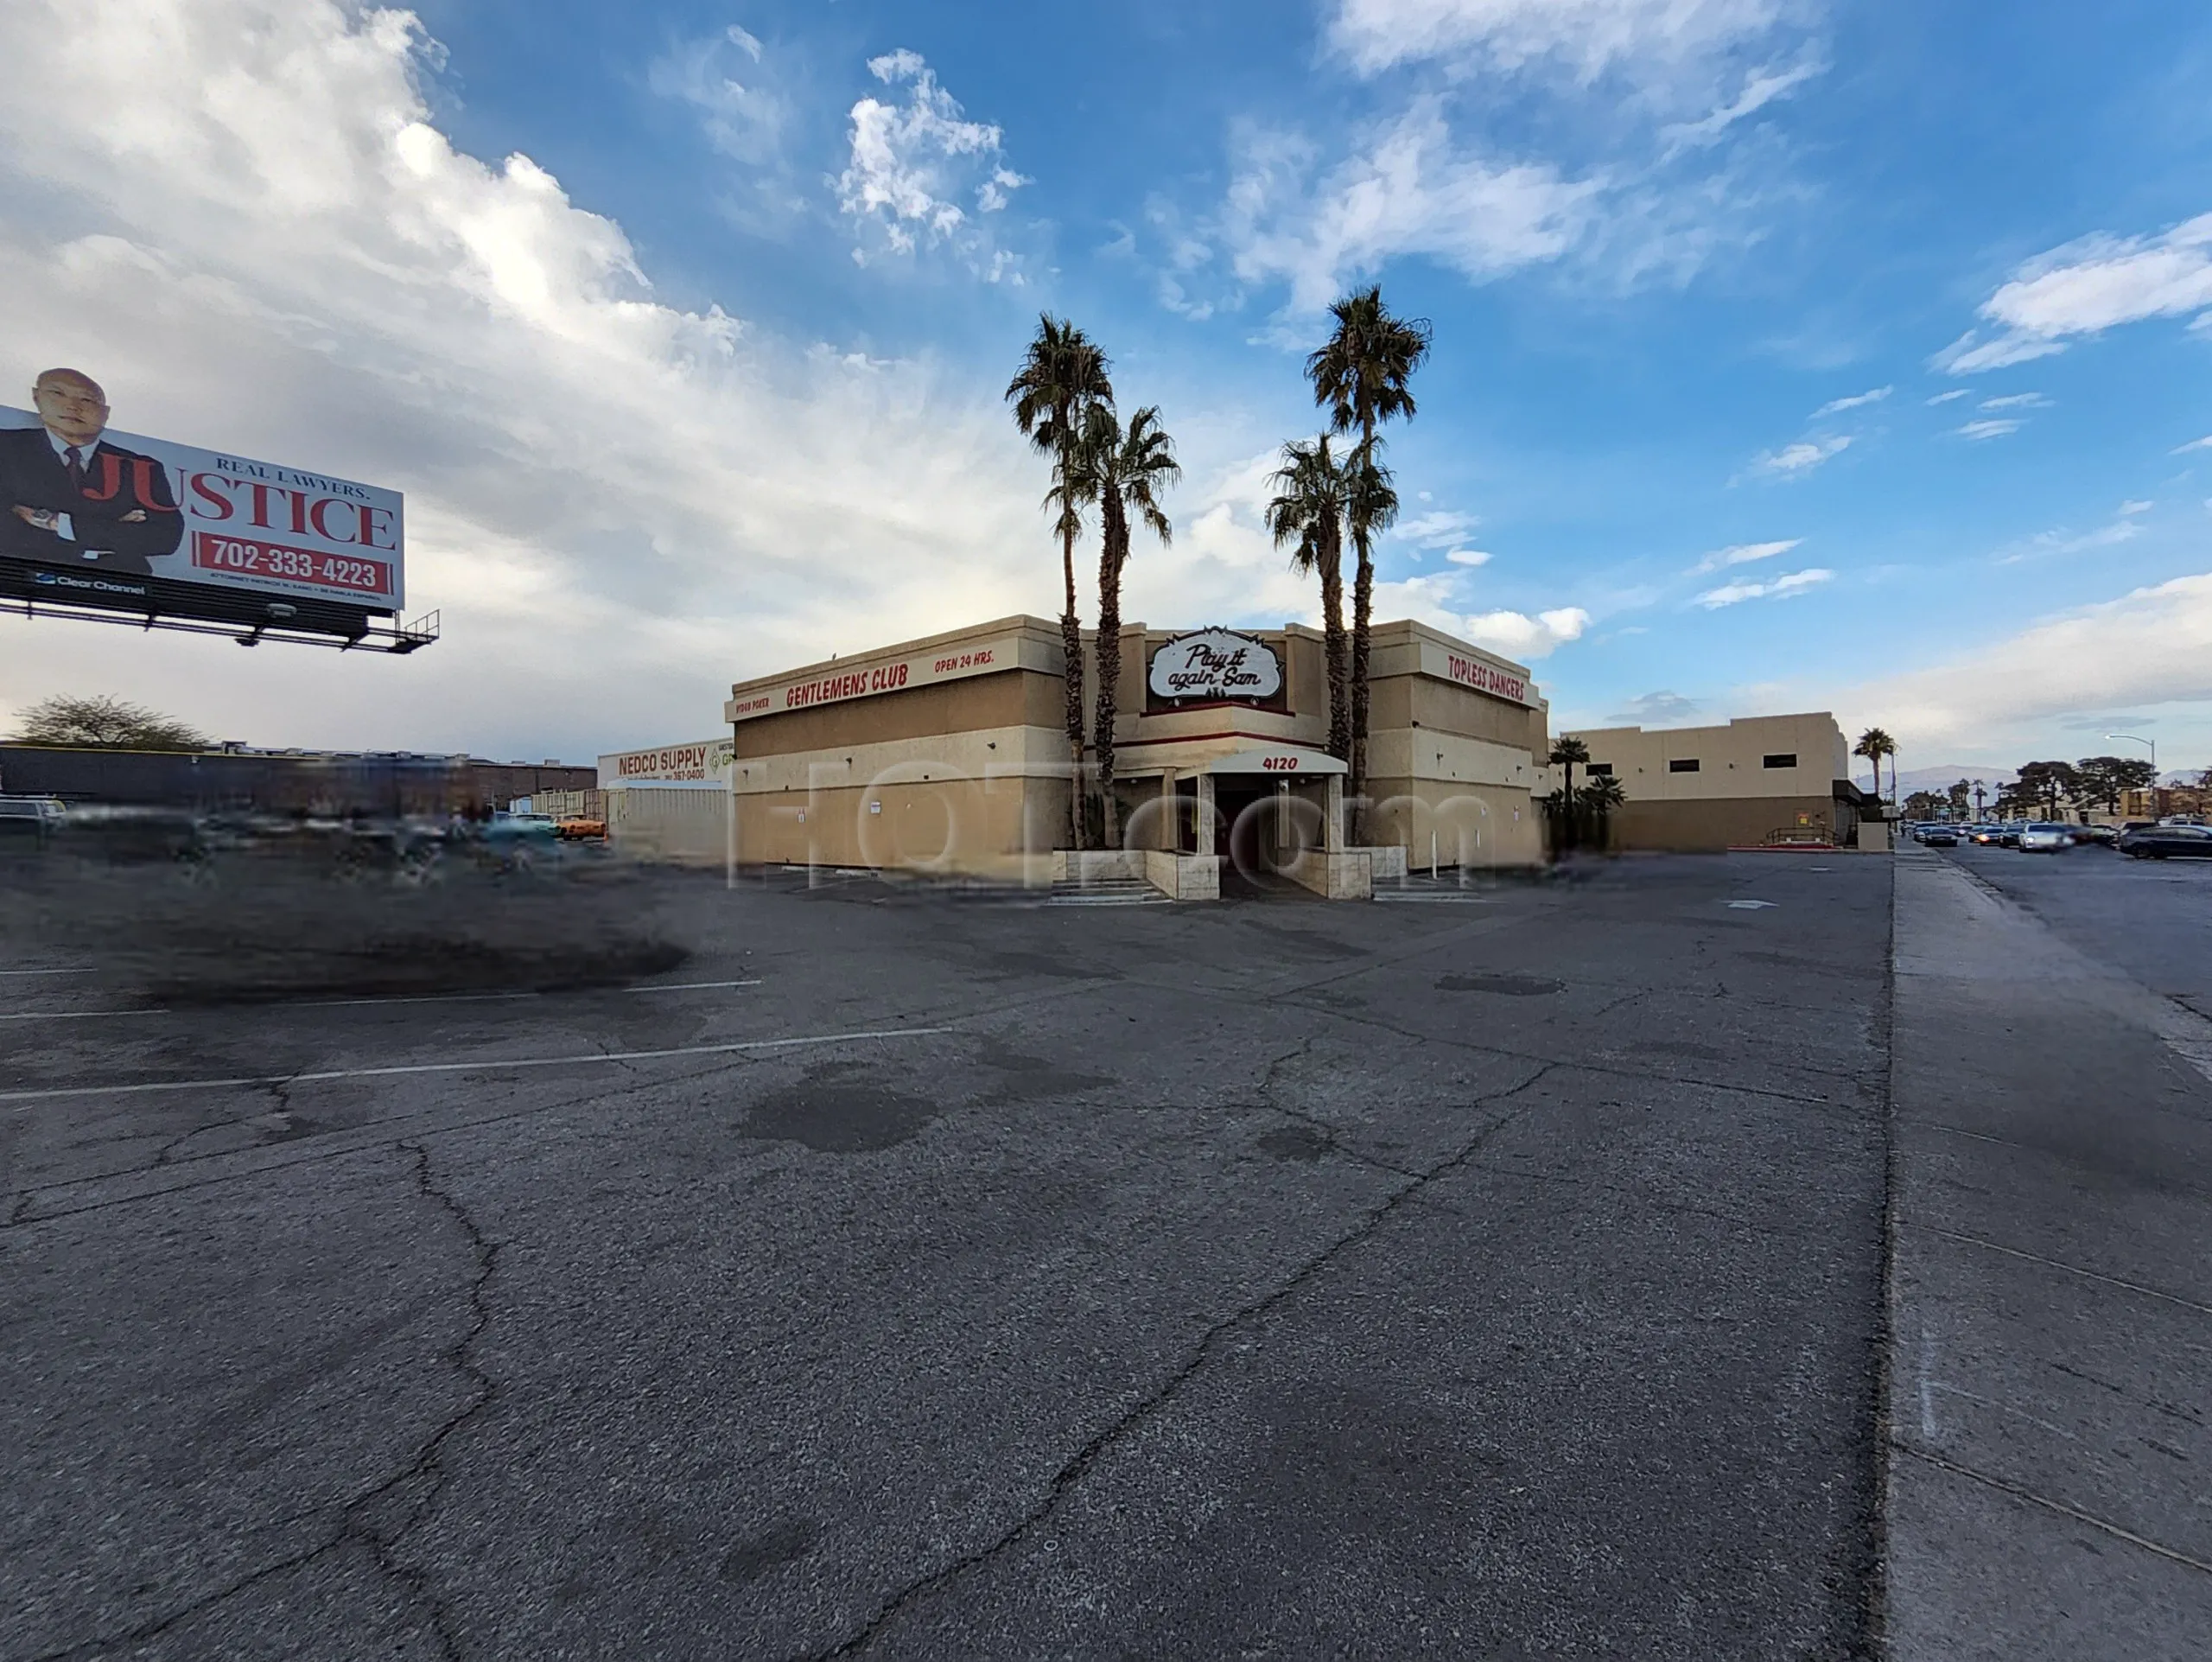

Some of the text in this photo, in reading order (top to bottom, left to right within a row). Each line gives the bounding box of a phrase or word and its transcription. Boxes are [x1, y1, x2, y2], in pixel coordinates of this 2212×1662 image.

[217, 457, 371, 500] REAL LAWYERS.
[82, 451, 396, 551] JUSTICE
[211, 539, 376, 587] 702-333-4223
[57, 576, 145, 595] Clear Channel
[934, 650, 995, 673] OPEN 24 HRS.
[1186, 644, 1248, 672] Play it
[786, 663, 908, 708] GENTLEMENS CLUB
[1168, 666, 1262, 691] again Sam
[1448, 654, 1524, 701] TOPLESS DANCERS
[619, 746, 707, 775] NEDCO SUPPLY
[1262, 756, 1299, 770] 4120
